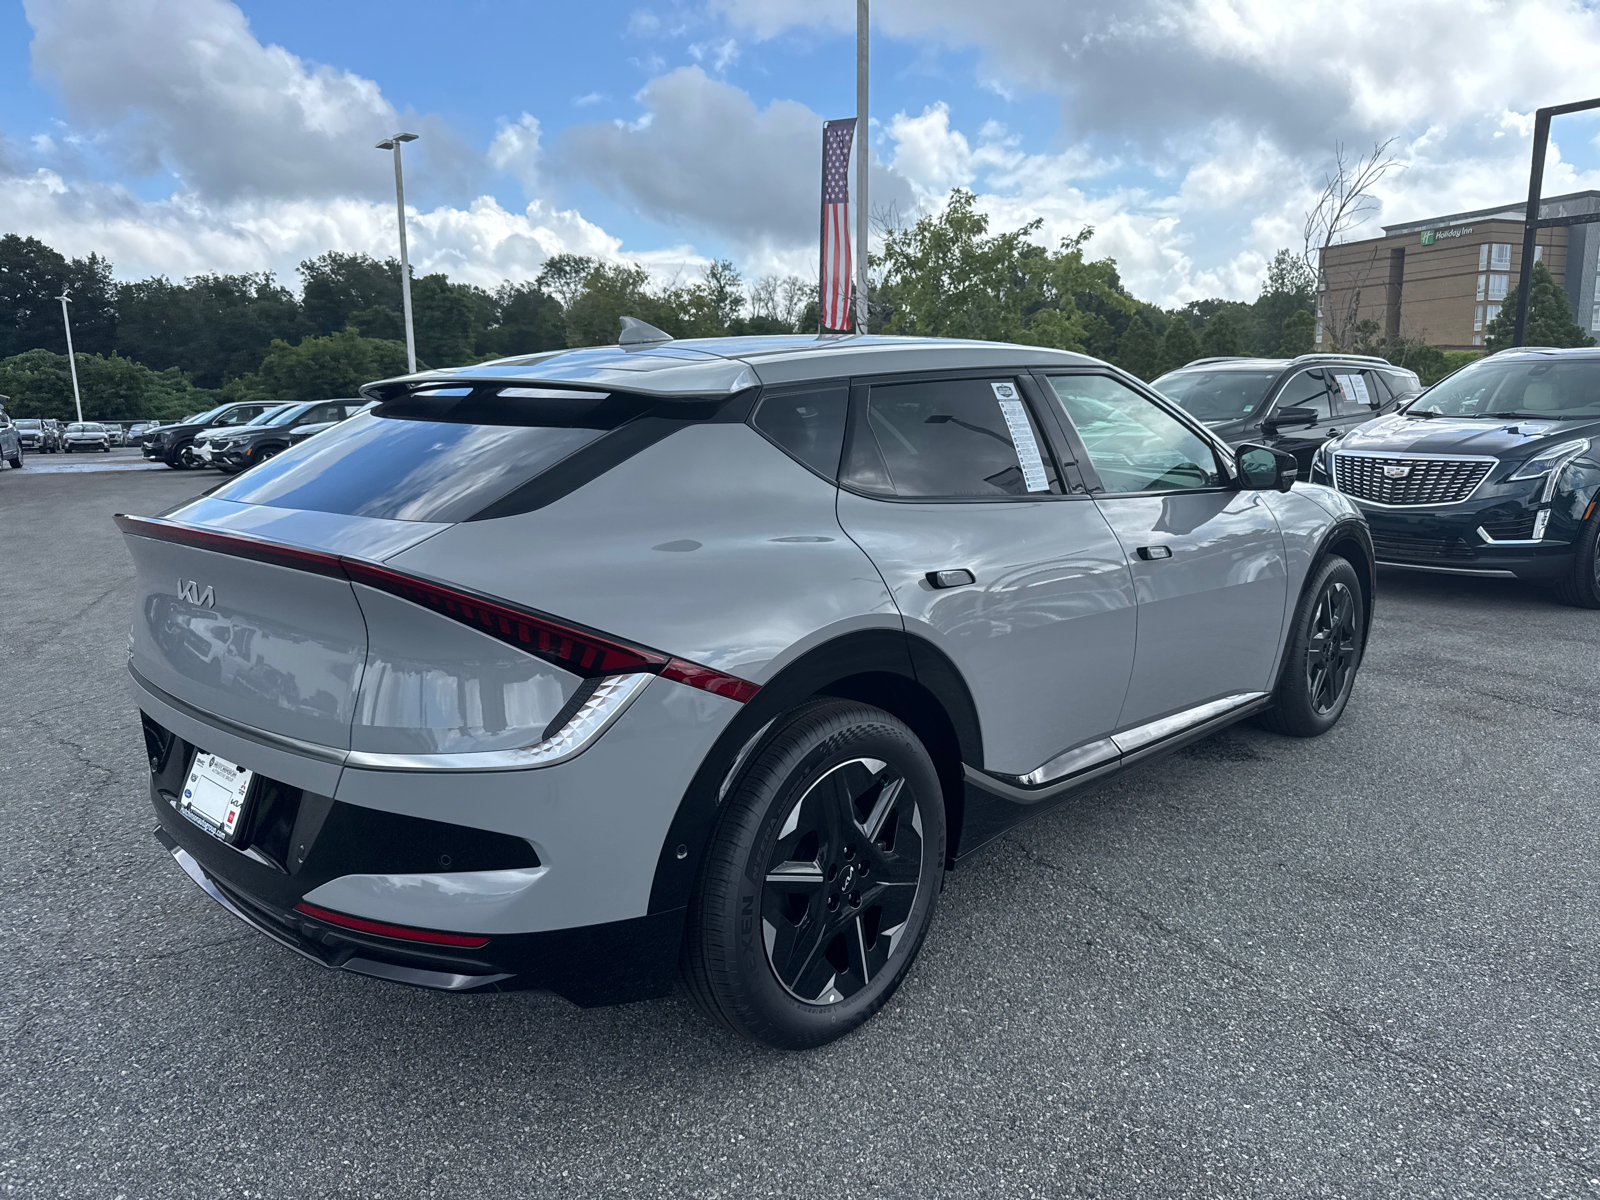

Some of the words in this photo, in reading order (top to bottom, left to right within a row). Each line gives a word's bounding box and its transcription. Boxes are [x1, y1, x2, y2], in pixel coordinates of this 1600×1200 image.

[1435, 229, 1461, 240] Holiday
[1461, 227, 1473, 235] Inn
[177, 578, 216, 609] KIA
